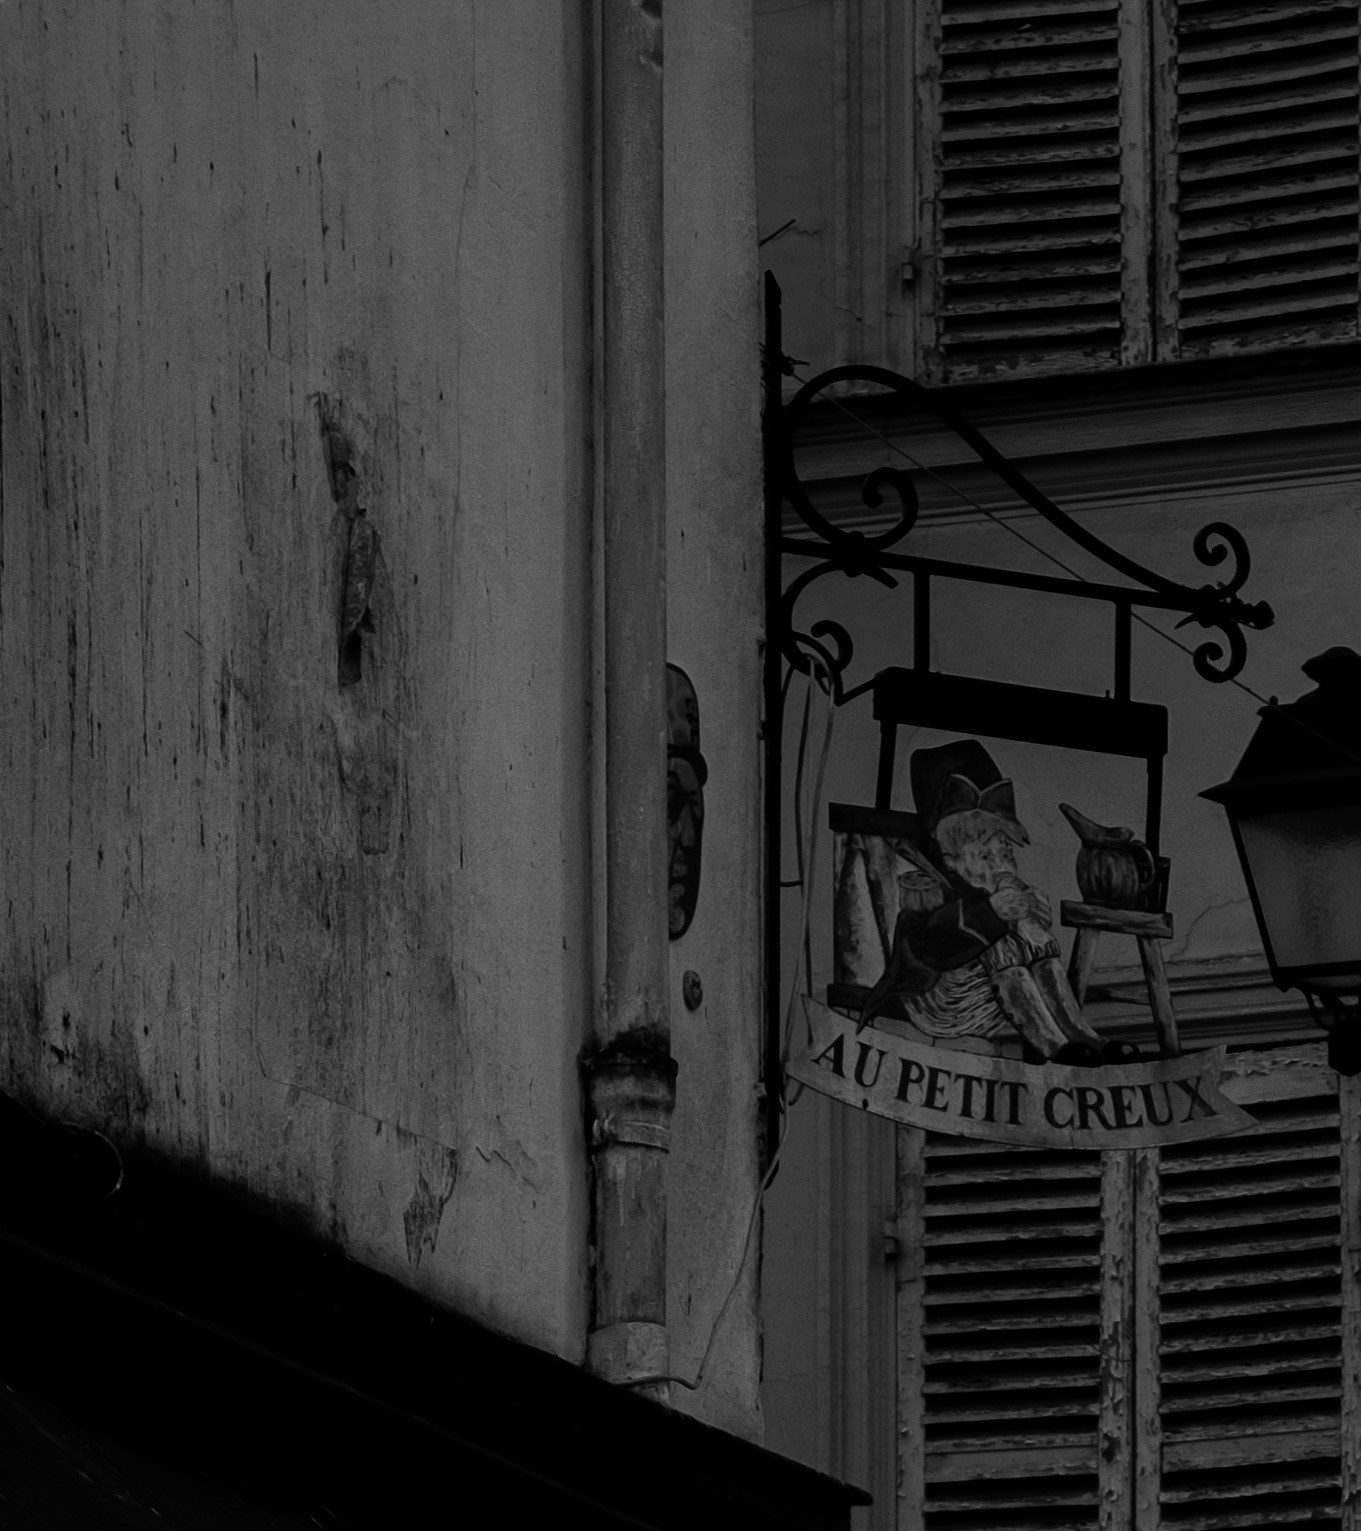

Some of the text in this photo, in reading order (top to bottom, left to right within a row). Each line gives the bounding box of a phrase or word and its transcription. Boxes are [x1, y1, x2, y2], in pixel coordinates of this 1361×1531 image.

[811, 1032, 1219, 1131] AU PETIT CREUX
